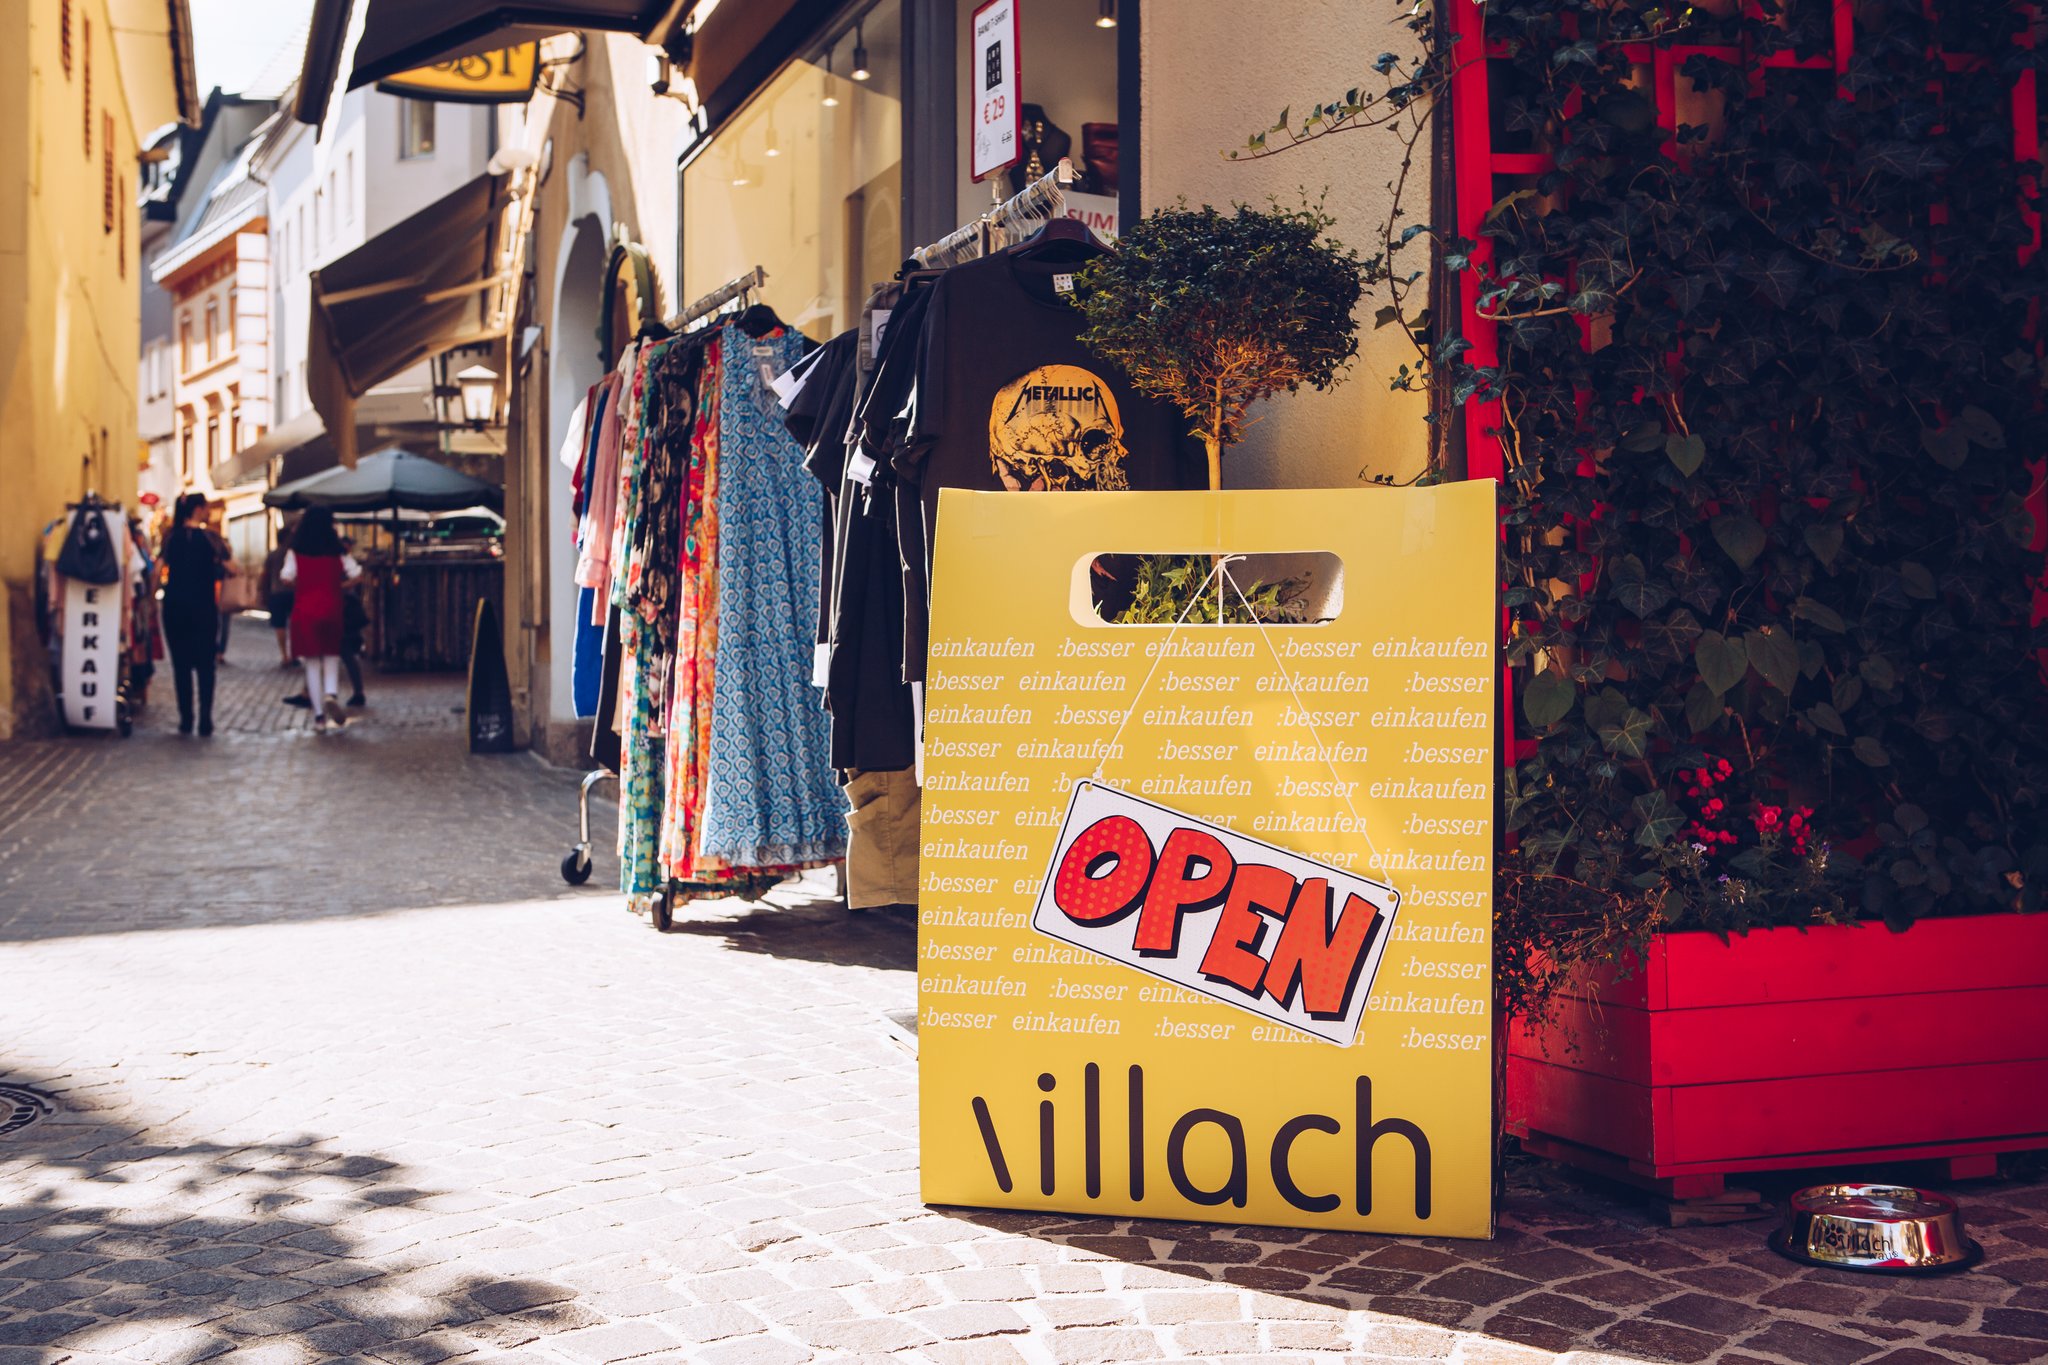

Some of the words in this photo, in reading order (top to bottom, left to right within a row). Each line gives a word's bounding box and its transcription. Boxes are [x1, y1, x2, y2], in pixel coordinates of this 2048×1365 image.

[993, 95, 1005, 120] 29
[1004, 379, 1116, 433] METALLICA
[931, 637, 1035, 657] einkaufen
[1056, 637, 1135, 657] :besser
[1144, 636, 1257, 659] einkaufen
[1279, 636, 1361, 657] :besser
[1372, 636, 1488, 657] einkaufen
[928, 670, 1004, 690] :besser
[1019, 670, 1126, 691] einkaufen
[1159, 671, 1240, 692] :besser
[1255, 671, 1370, 692] einkaufen
[1404, 672, 1489, 693] :besser
[927, 704, 1032, 724] einkaufen
[1053, 705, 1132, 725] :besser
[1143, 705, 1253, 726] einkaufen
[1276, 706, 1360, 727] :besser
[1371, 706, 1487, 728] einkaufen
[927, 737, 1002, 758] :besser
[1016, 738, 1125, 759] einkaufen
[1157, 739, 1239, 760] :besser
[1253, 740, 1369, 762] einkaufen
[1403, 742, 1489, 764] :besser
[925, 771, 1030, 792] einkaufen
[1141, 774, 1252, 796] einkaufen
[1275, 776, 1358, 798] :besser
[1370, 777, 1486, 800] einkaufen
[922, 804, 1000, 825] :besser
[1252, 810, 1367, 833] einkaufen
[1402, 813, 1488, 836] :besser
[921, 838, 1028, 860] einkaufen
[1368, 848, 1486, 871] einkaufen
[920, 872, 999, 893] :besser
[921, 906, 1027, 928] einkaufen
[1389, 920, 1485, 943] nkaufen
[1054, 815, 1385, 1021] OPEN
[920, 939, 999, 961] :besser
[1401, 956, 1487, 979] :besser
[921, 974, 1027, 997] einkaufen
[1049, 978, 1128, 1001] :besser
[1366, 990, 1486, 1013] einkaufen
[921, 1007, 998, 1029] :besser
[1012, 1011, 1120, 1035] einkaufen
[1154, 1016, 1236, 1040] :besser
[1401, 1027, 1487, 1051] :besser
